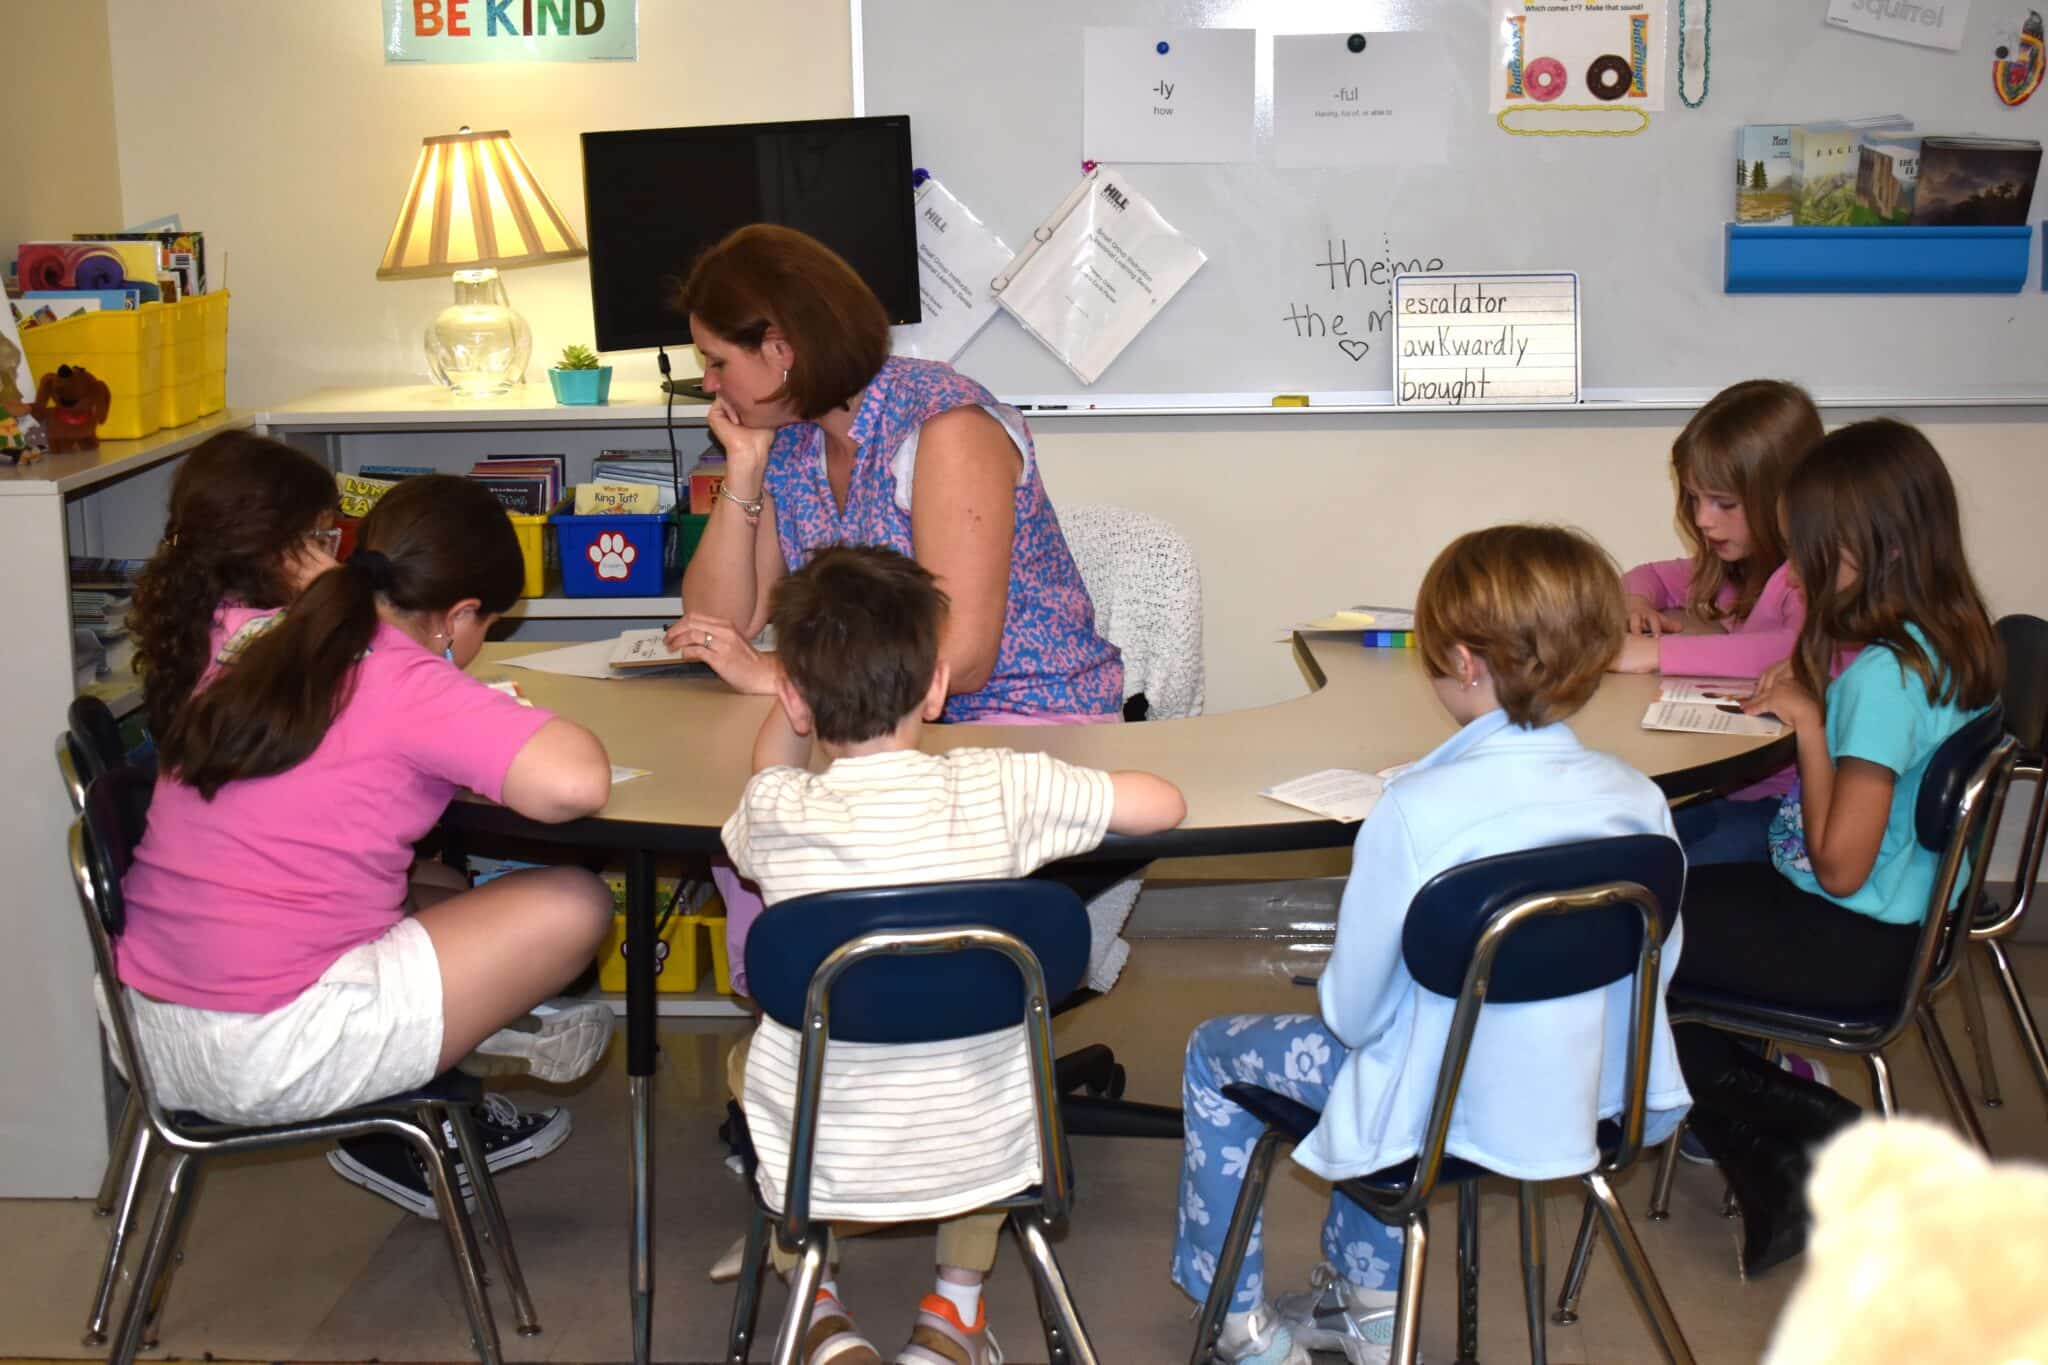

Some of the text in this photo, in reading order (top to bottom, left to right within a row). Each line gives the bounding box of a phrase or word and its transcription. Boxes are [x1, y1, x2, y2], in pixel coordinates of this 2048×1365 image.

[413, 0, 606, 36] BE KIND
[1153, 80, 1174, 99] -ly
[1153, 106, 1173, 116] how
[1103, 183, 1129, 210] HILL
[924, 207, 947, 233] HILL
[1405, 283, 1508, 314] escalator
[1282, 303, 1348, 337] the
[1402, 367, 1491, 406] brought
[594, 493, 639, 506] King Tut?
